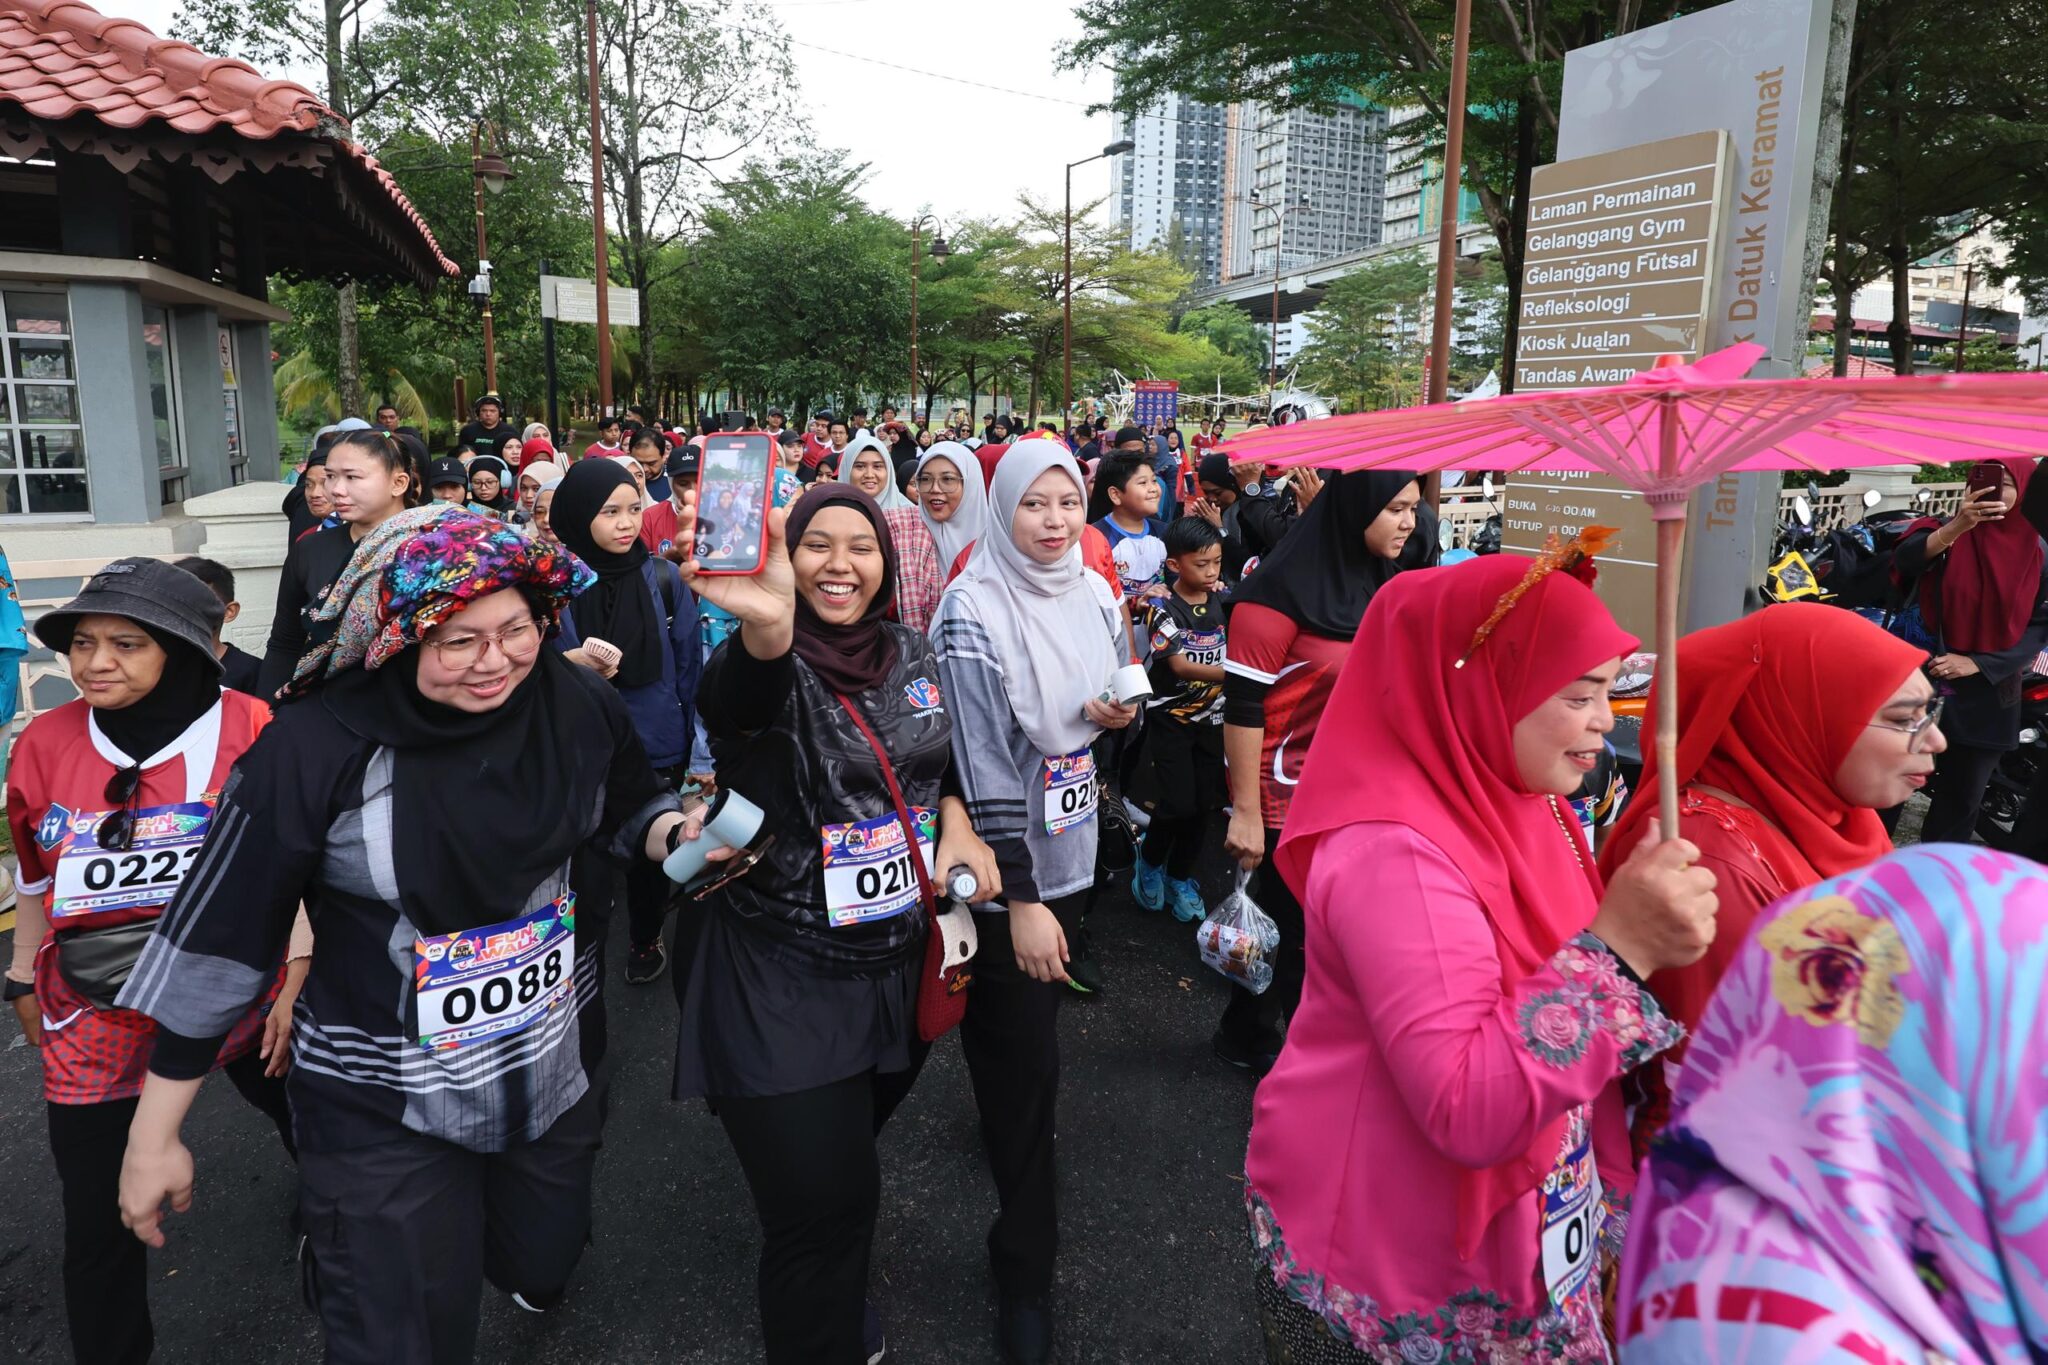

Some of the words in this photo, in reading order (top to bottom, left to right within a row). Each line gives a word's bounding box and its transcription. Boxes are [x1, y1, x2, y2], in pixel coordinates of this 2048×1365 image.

[1739, 65, 1785, 214] Keramat
[1531, 200, 1587, 222] Laman
[1592, 181, 1696, 211] Permainan
[1528, 225, 1634, 252] Gelanggang
[1639, 217, 1686, 240] Gym
[1526, 260, 1631, 286] Gelanggang
[1636, 248, 1698, 273] Futsal
[1728, 223, 1768, 322] Datuk
[1522, 292, 1631, 318] Refleksologi
[1519, 334, 1566, 352] Kiosk
[1571, 330, 1631, 350] Jualan
[1518, 367, 1577, 384] Tandas
[1580, 365, 1637, 383] Awam
[1508, 499, 1537, 511] BUKA
[1705, 471, 1739, 532] Tam
[1507, 519, 1543, 532] TUTUP
[869, 830, 904, 848] WALK
[873, 821, 898, 838] FUN
[480, 931, 540, 960] WALK
[486, 921, 533, 948] FUN
[442, 949, 562, 1025] 0088
